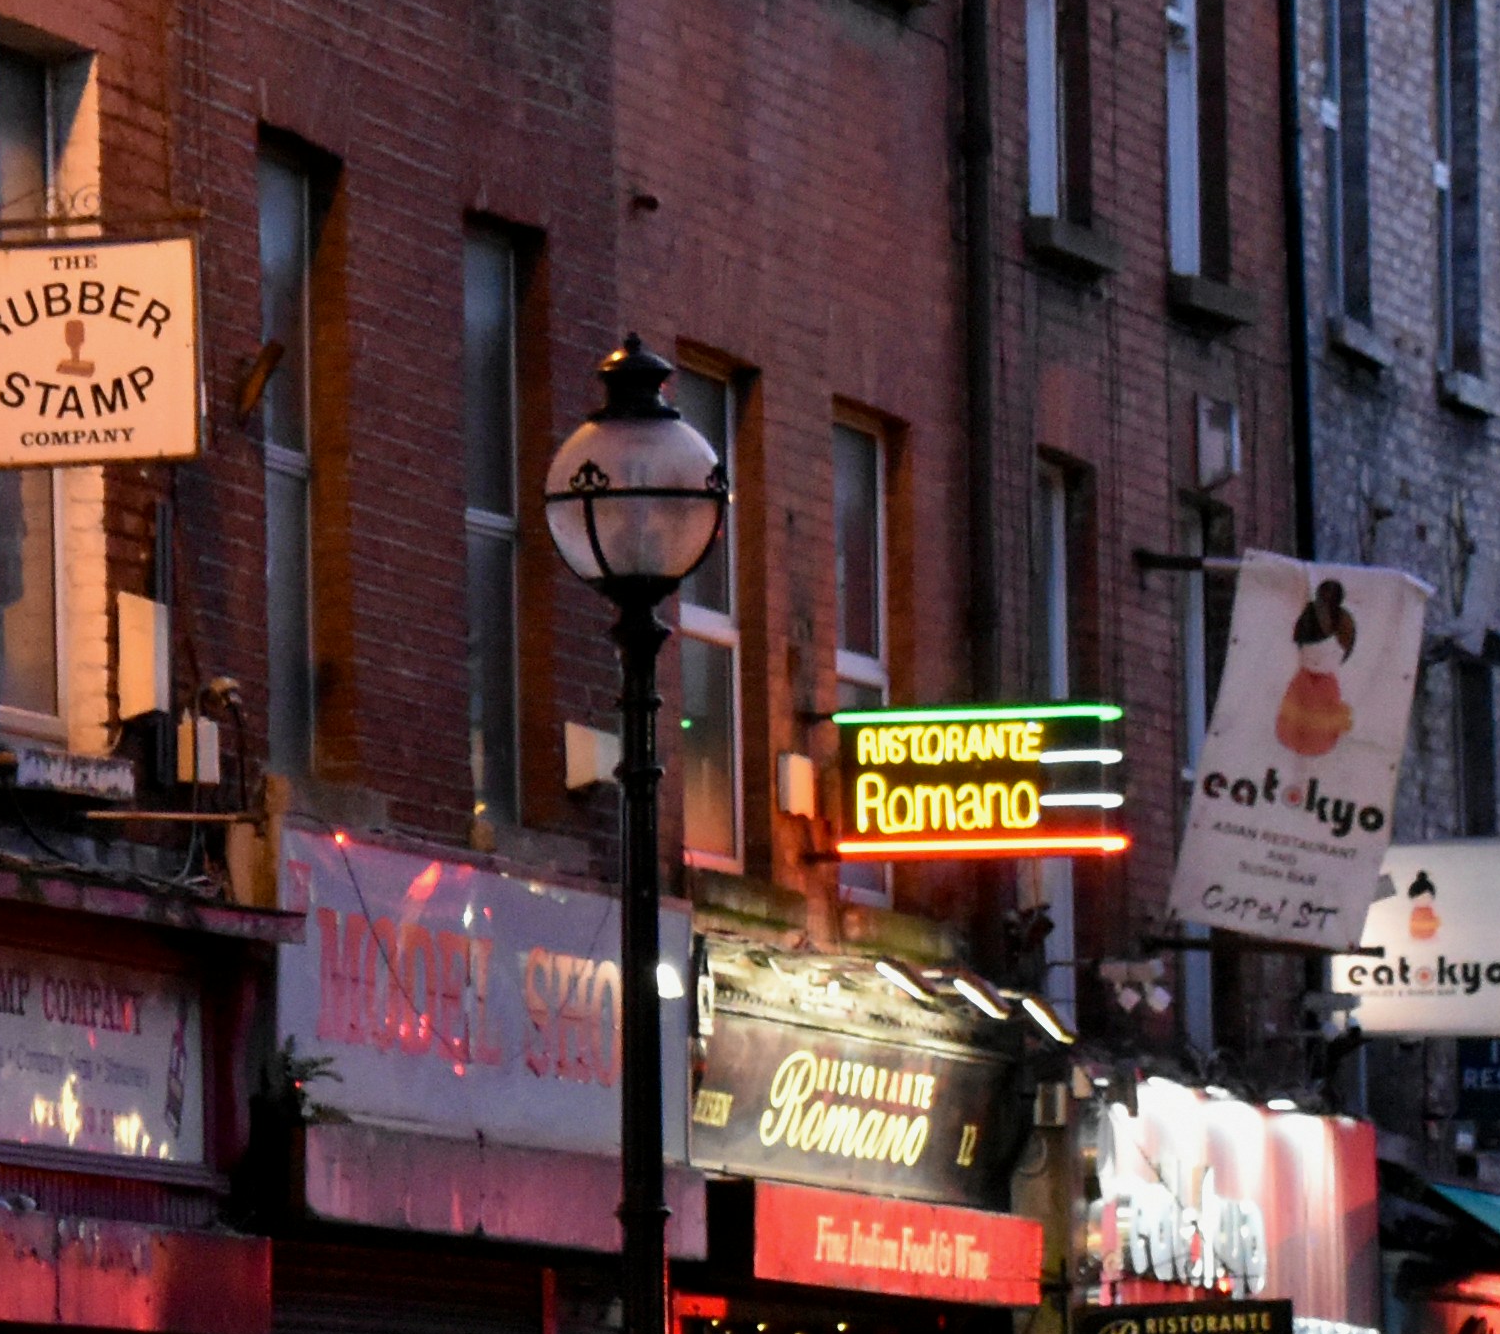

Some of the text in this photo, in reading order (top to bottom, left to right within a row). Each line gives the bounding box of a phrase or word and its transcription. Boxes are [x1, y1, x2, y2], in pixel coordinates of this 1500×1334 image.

[49, 254, 97, 270] THE
[20, 427, 134, 447] COMPANY
[857, 722, 1044, 765] RISTORANTE
[856, 772, 1040, 834] Romano
[42, 976, 143, 1036] COMPANY
[316, 906, 623, 1088] MODEL SHO
[759, 1049, 930, 1167] Romano
[816, 1057, 937, 1110] RISTORANTE
[814, 1215, 849, 1264] Fine
[850, 1220, 900, 1270] Italian
[901, 1227, 936, 1275] Food
[954, 1233, 990, 1282] Wine
